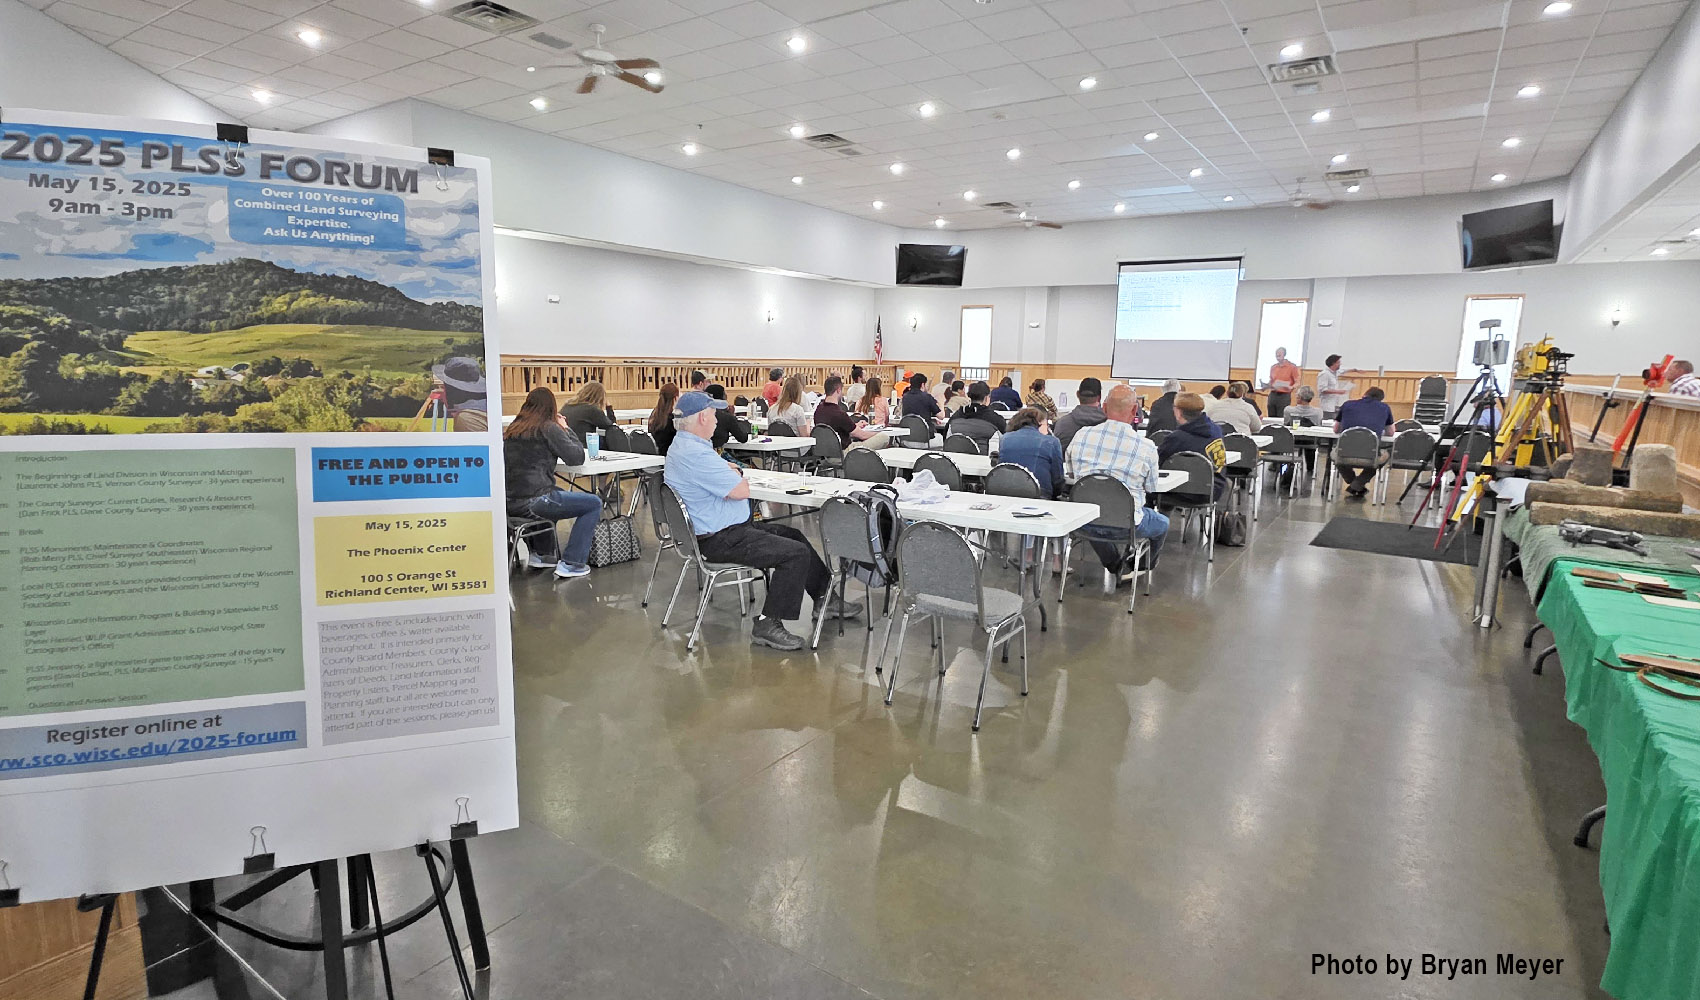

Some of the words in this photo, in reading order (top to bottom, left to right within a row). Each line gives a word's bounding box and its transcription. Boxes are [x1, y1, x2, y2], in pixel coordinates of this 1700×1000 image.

[1, 130, 126, 167] 2025
[140, 140, 246, 177] PLSS
[259, 152, 419, 194] FORUM
[28, 173, 80, 193] May
[89, 177, 124, 195] 15,
[131, 179, 191, 196] 2025
[262, 188, 293, 199] Over
[298, 191, 321, 201] 100
[324, 193, 358, 204] Years
[361, 197, 374, 205] of
[49, 199, 100, 215] 9am
[121, 202, 173, 221] 3pm
[234, 199, 301, 212] Combined
[304, 205, 335, 215] Land
[338, 207, 399, 222] Surveying
[288, 216, 351, 230] Expertise.
[263, 227, 288, 237] Ask
[291, 229, 307, 239] Us
[310, 231, 375, 246] Anything!
[318, 459, 364, 470] FREE
[368, 458, 408, 469] AND
[414, 458, 459, 468] OPEN
[464, 457, 484, 467] TO
[347, 475, 383, 485] THE
[389, 473, 458, 484] PUBLIC!
[365, 522, 391, 531] May
[396, 521, 413, 530] 15,
[417, 519, 447, 528] 2025
[347, 549, 370, 557] The
[374, 546, 423, 556] Phoenix
[427, 544, 467, 553] Center
[361, 574, 383, 583] 100
[387, 574, 392, 582] S
[397, 571, 442, 581] Orange
[446, 570, 456, 578] St
[325, 588, 381, 598] Richland
[384, 586, 428, 595] Center,
[432, 583, 447, 591] WI
[451, 581, 487, 590] 53581
[321, 623, 337, 631] This
[340, 621, 365, 630] event
[375, 619, 392, 627] free
[403, 615, 437, 625] includes
[466, 612, 484, 620] with
[370, 629, 397, 638] coffee
[409, 626, 432, 635] water
[434, 623, 470, 633] available
[395, 638, 433, 647] intended
[435, 634, 470, 646] primarily
[321, 655, 354, 667] County
[356, 653, 382, 662] Board
[429, 646, 458, 657] County
[470, 643, 490, 652] Local
[323, 678, 344, 687] isters
[390, 672, 411, 681] Land
[413, 667, 461, 678] Information
[323, 688, 360, 699] Property
[392, 682, 417, 691] Parcel
[419, 678, 457, 690] Mapping
[459, 676, 475, 684] and
[323, 698, 362, 710] Planning
[386, 694, 400, 703] but
[403, 693, 412, 701] all
[431, 687, 467, 698] welcome
[367, 709, 383, 717] you
[402, 701, 442, 712] interested
[478, 696, 495, 705] only
[324, 722, 354, 732] attend
[356, 720, 373, 729] part
[386, 717, 399, 725] the
[439, 710, 464, 720] please
[465, 708, 482, 717] join
[485, 706, 495, 714] us!
[47, 726, 128, 745] Register
[134, 717, 197, 735] online
[202, 715, 222, 727] at
